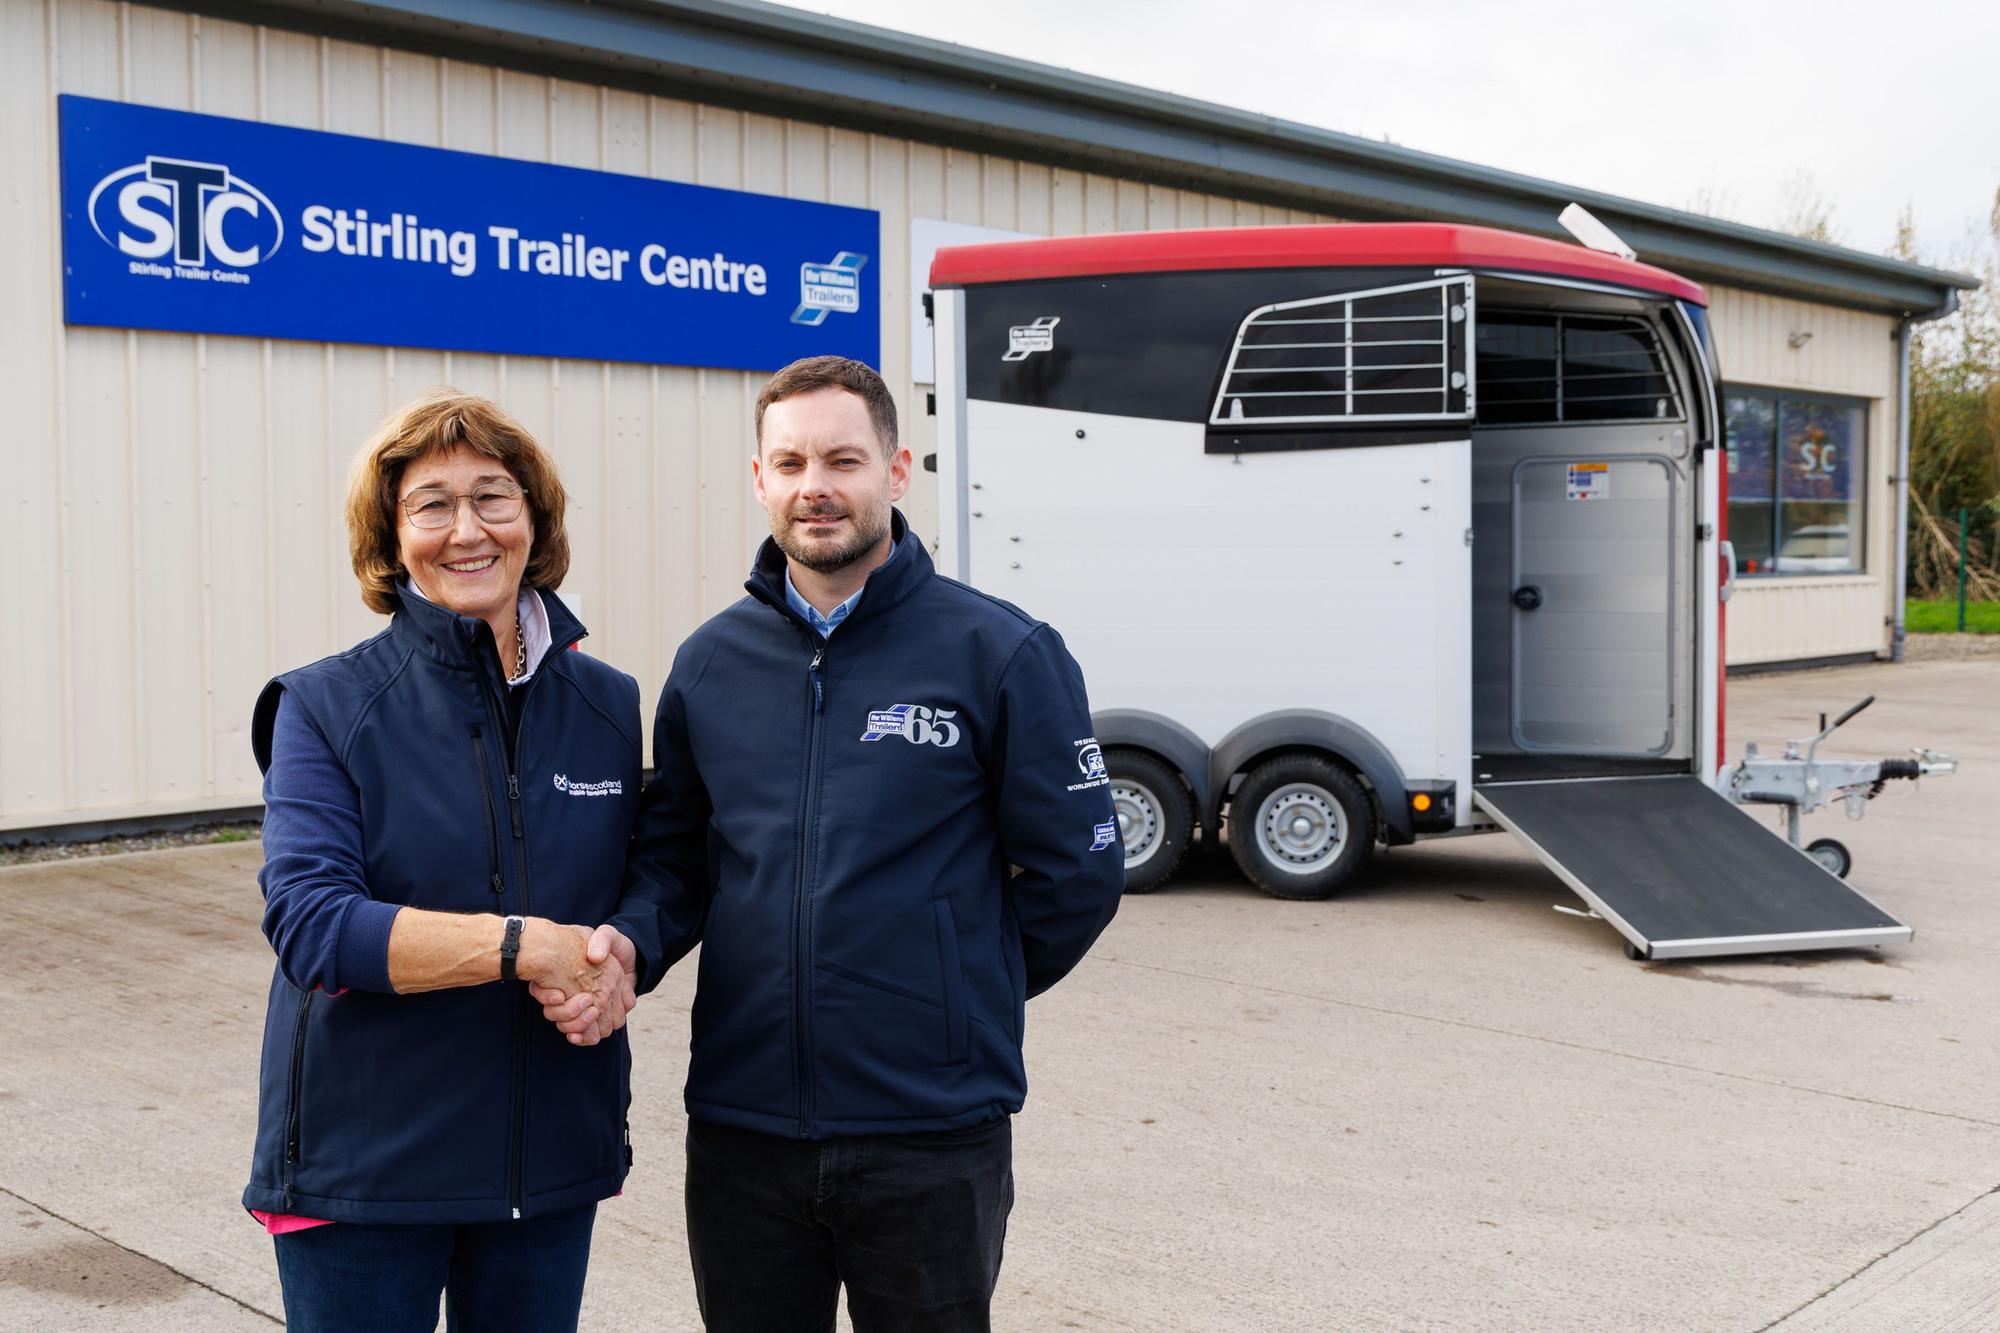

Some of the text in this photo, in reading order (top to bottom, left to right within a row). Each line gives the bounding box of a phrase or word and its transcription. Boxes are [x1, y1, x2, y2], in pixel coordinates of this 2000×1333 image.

[117, 155, 260, 268] STC
[301, 204, 767, 296] Stirling Trailer Centre
[128, 261, 250, 284] Stirling Trailer Centre
[806, 287, 855, 305] Trailers
[903, 705, 960, 747] 65
